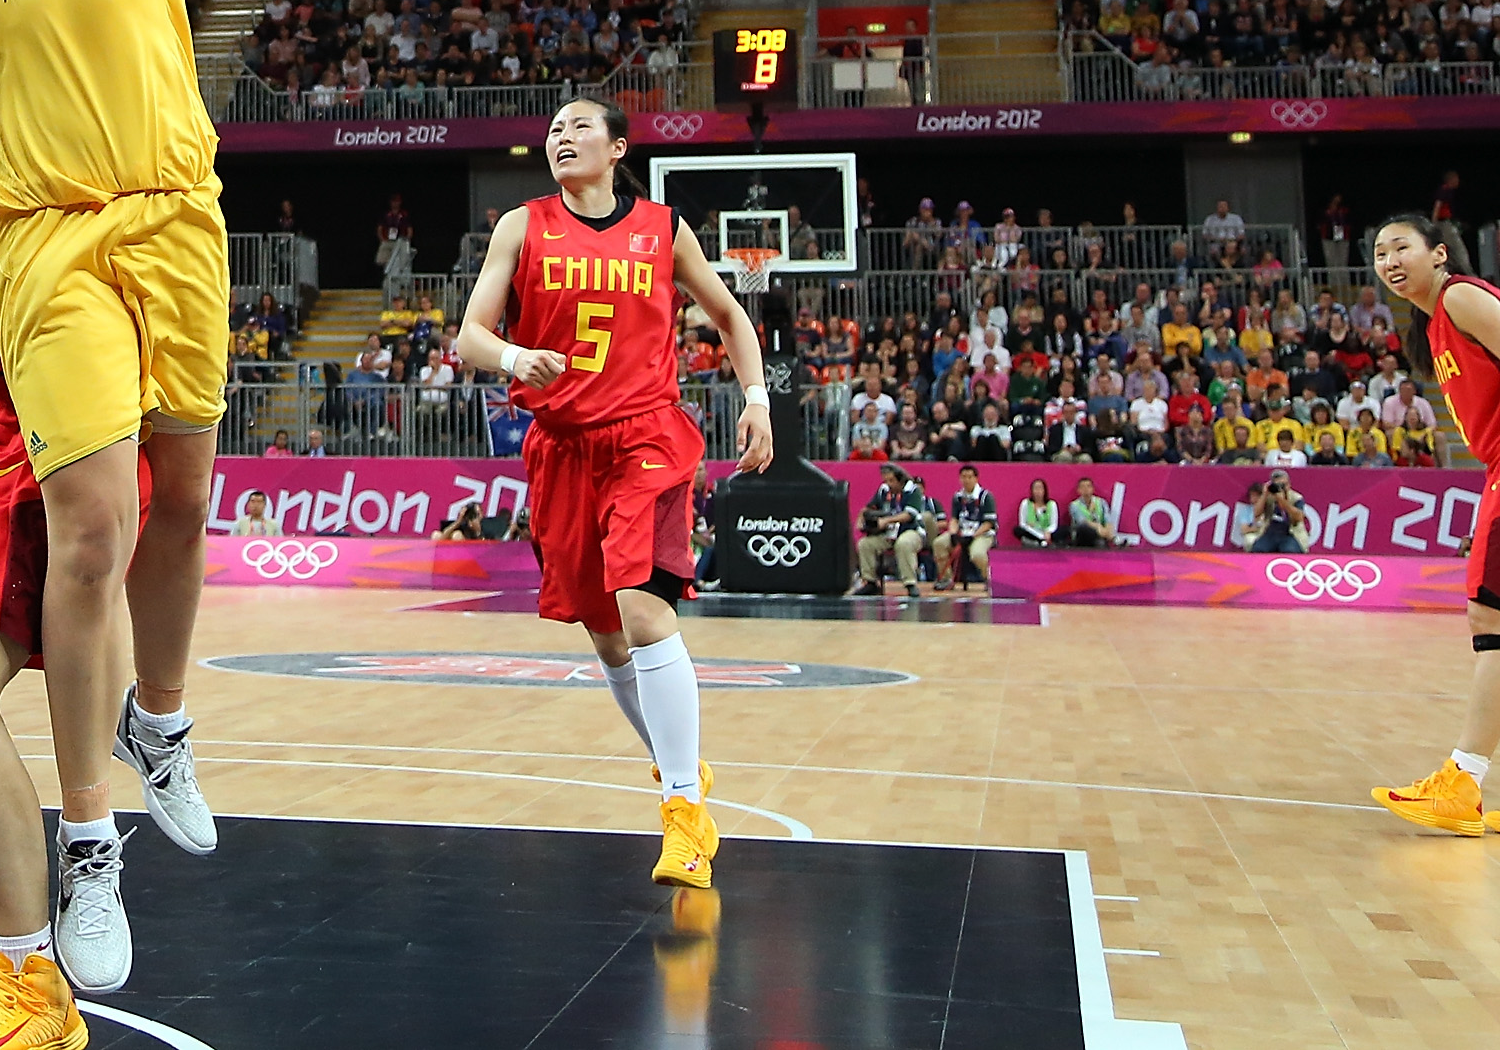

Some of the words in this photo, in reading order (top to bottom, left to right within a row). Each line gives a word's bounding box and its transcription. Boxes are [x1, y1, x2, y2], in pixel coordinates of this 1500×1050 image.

[736, 29, 787, 53] 3:08
[755, 52, 778, 84] 8
[335, 126, 401, 146] London
[406, 125, 448, 143] 2012
[917, 109, 991, 132] London
[995, 109, 1043, 129] 2012
[543, 256, 653, 297] CHINA
[571, 301, 614, 373] 5
[207, 471, 431, 533] London
[1392, 486, 1481, 549] 20
[737, 515, 789, 532] London
[790, 517, 824, 533] 2012
